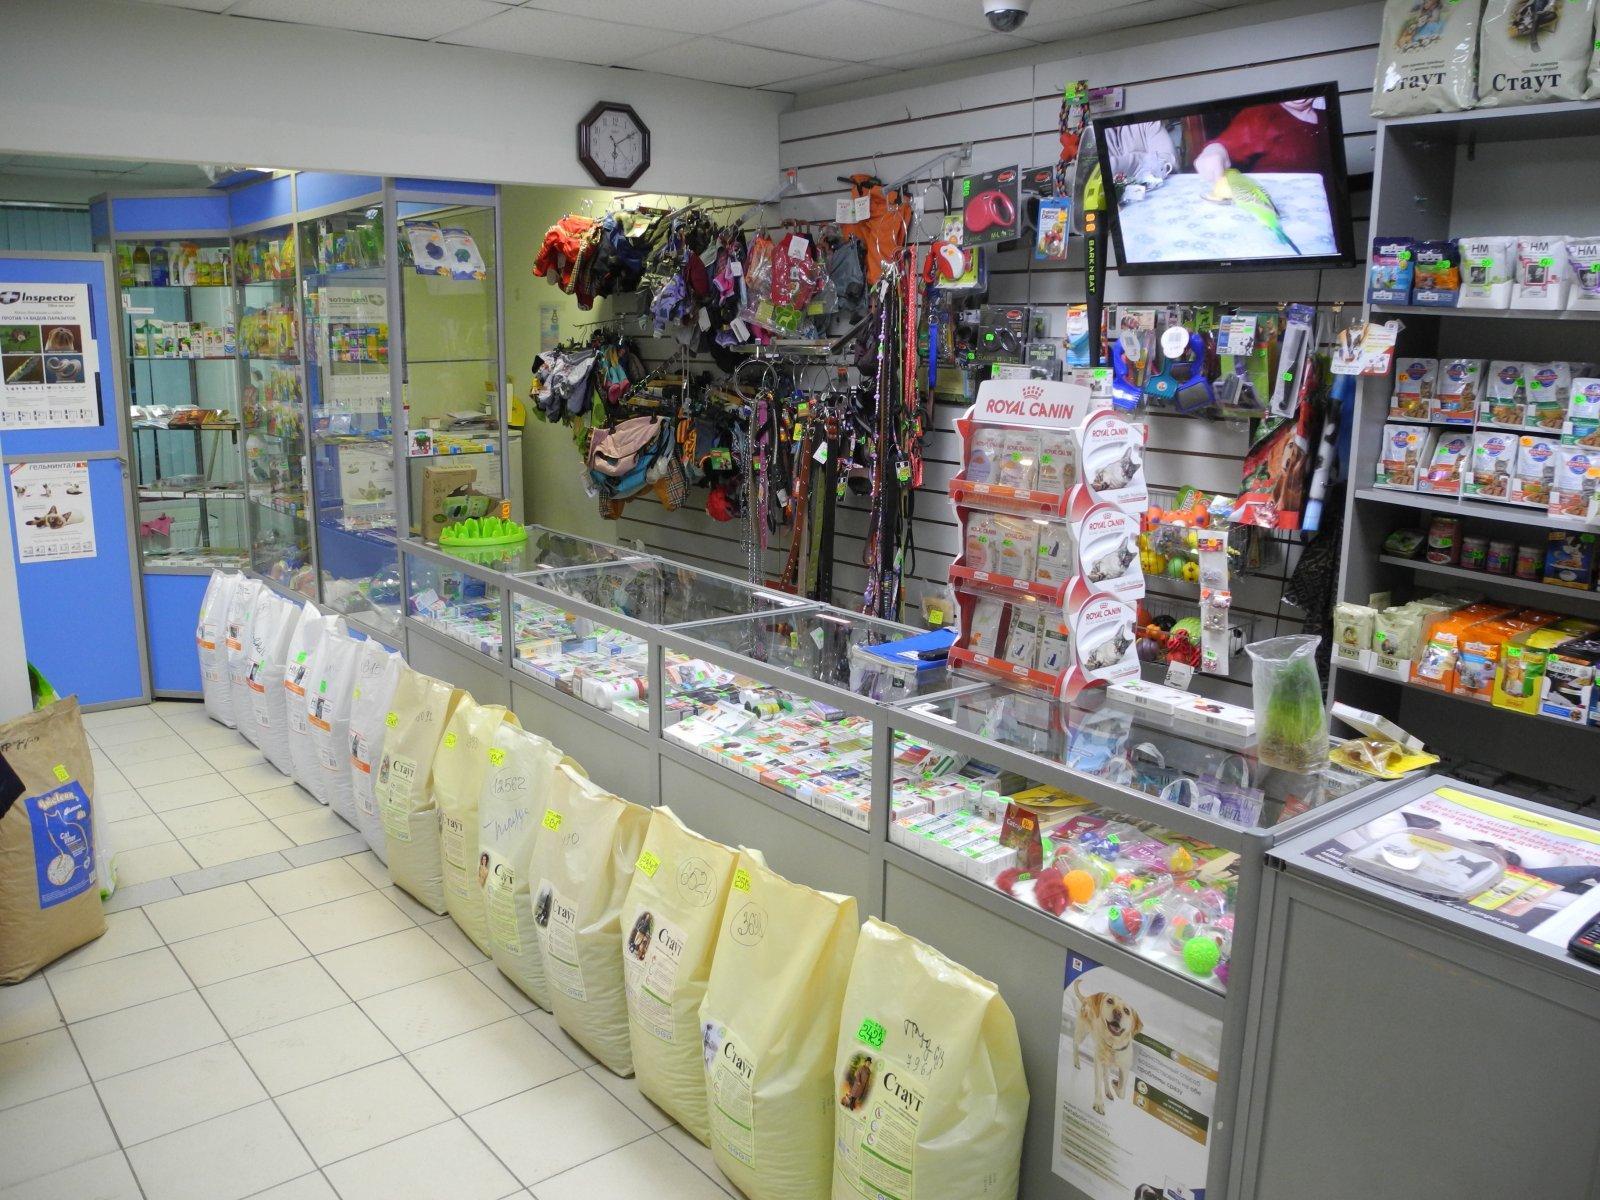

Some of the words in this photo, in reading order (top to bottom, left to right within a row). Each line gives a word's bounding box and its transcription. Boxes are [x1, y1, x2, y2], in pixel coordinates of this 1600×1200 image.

[1385, 72, 1447, 93] таут
[1492, 73, 1562, 93] Стаут
[1088, 239, 1096, 265] BARK
[1088, 275, 1096, 293] BAT
[21, 292, 76, 303] Inspector
[985, 399, 1025, 416] ROYAL
[1028, 402, 1074, 420] CANIN
[1092, 429, 1109, 438] ROYAL
[1110, 428, 1128, 437] CANIN
[1088, 521, 1107, 531] ROYAL
[1108, 518, 1126, 528] CANIN
[1085, 610, 1103, 621] ROYAL
[1103, 607, 1122, 617] CANIN
[393, 760, 415, 778] Стаут
[494, 863, 514, 886] Саут
[552, 897, 576, 924] Стаут
[658, 928, 683, 957] Стаут
[723, 1041, 755, 1080] Стаут
[883, 1072, 924, 1112] Стаут
